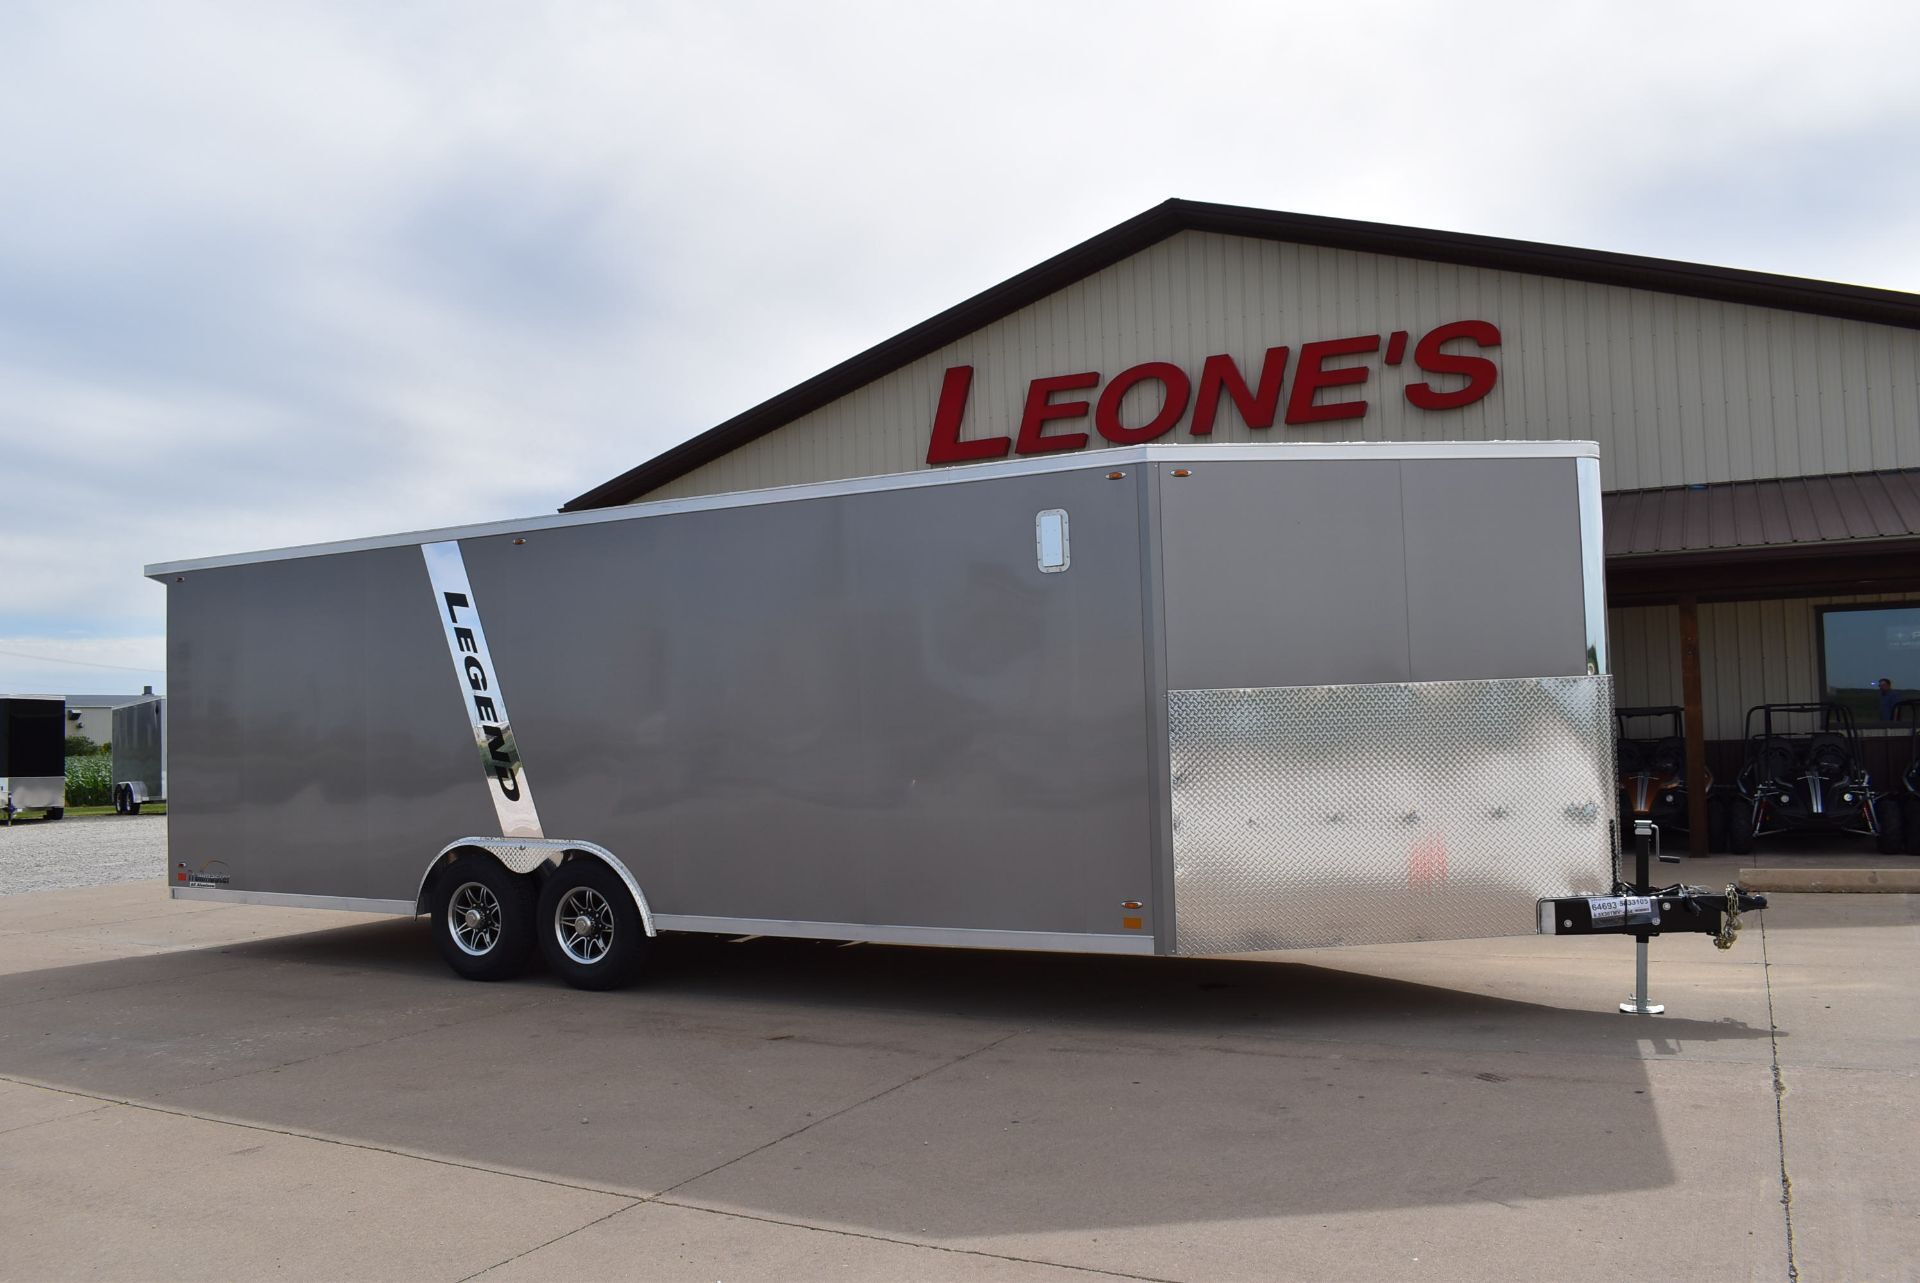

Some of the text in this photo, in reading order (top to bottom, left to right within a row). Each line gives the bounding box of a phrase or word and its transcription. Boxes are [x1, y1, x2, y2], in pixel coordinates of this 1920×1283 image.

[926, 320, 1501, 465] LEONE'S
[443, 591, 521, 802] LEGEND
[1592, 901, 1617, 911] 64693
